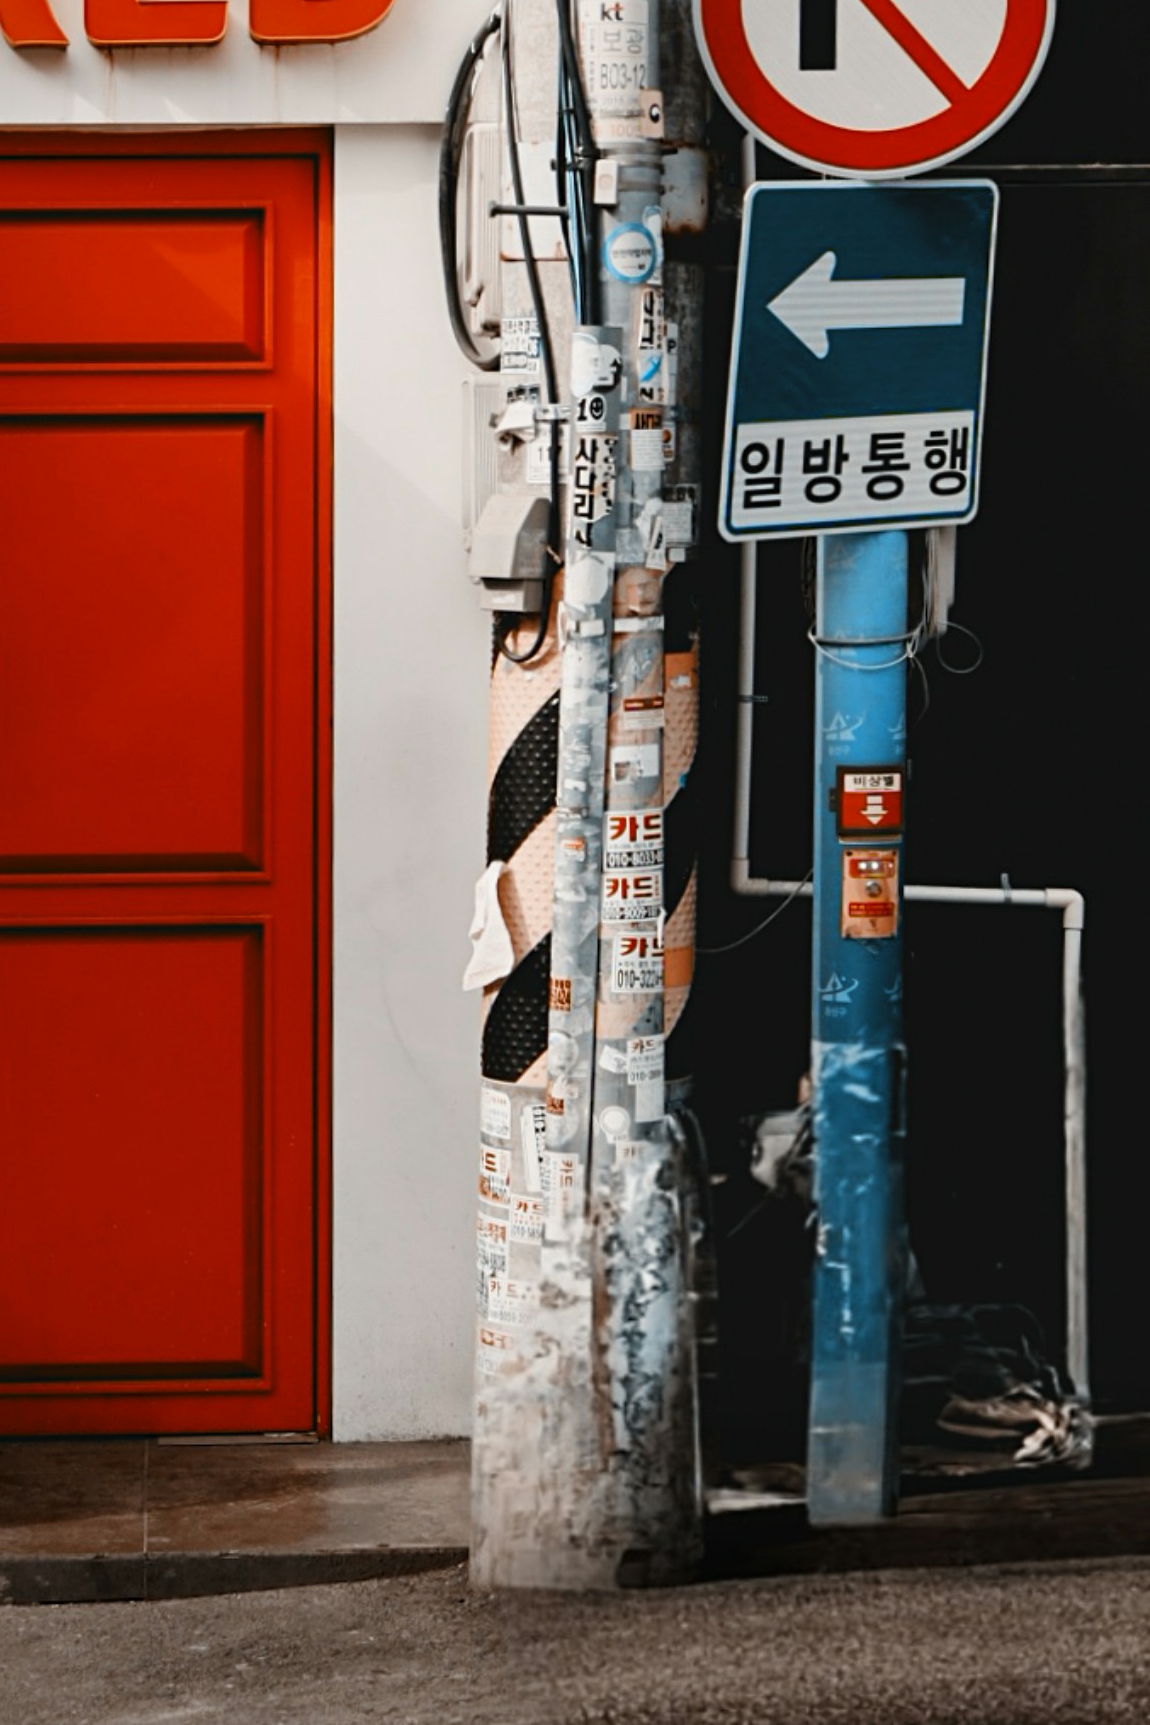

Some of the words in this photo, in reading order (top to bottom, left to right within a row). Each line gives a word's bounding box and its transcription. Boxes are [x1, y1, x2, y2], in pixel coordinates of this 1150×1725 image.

[600, 2, 624, 22] kt
[740, 426, 969, 510] 일방통행
[853, 775, 895, 788] 비상벨
[609, 814, 662, 842] 카드
[606, 876, 653, 900] 카드
